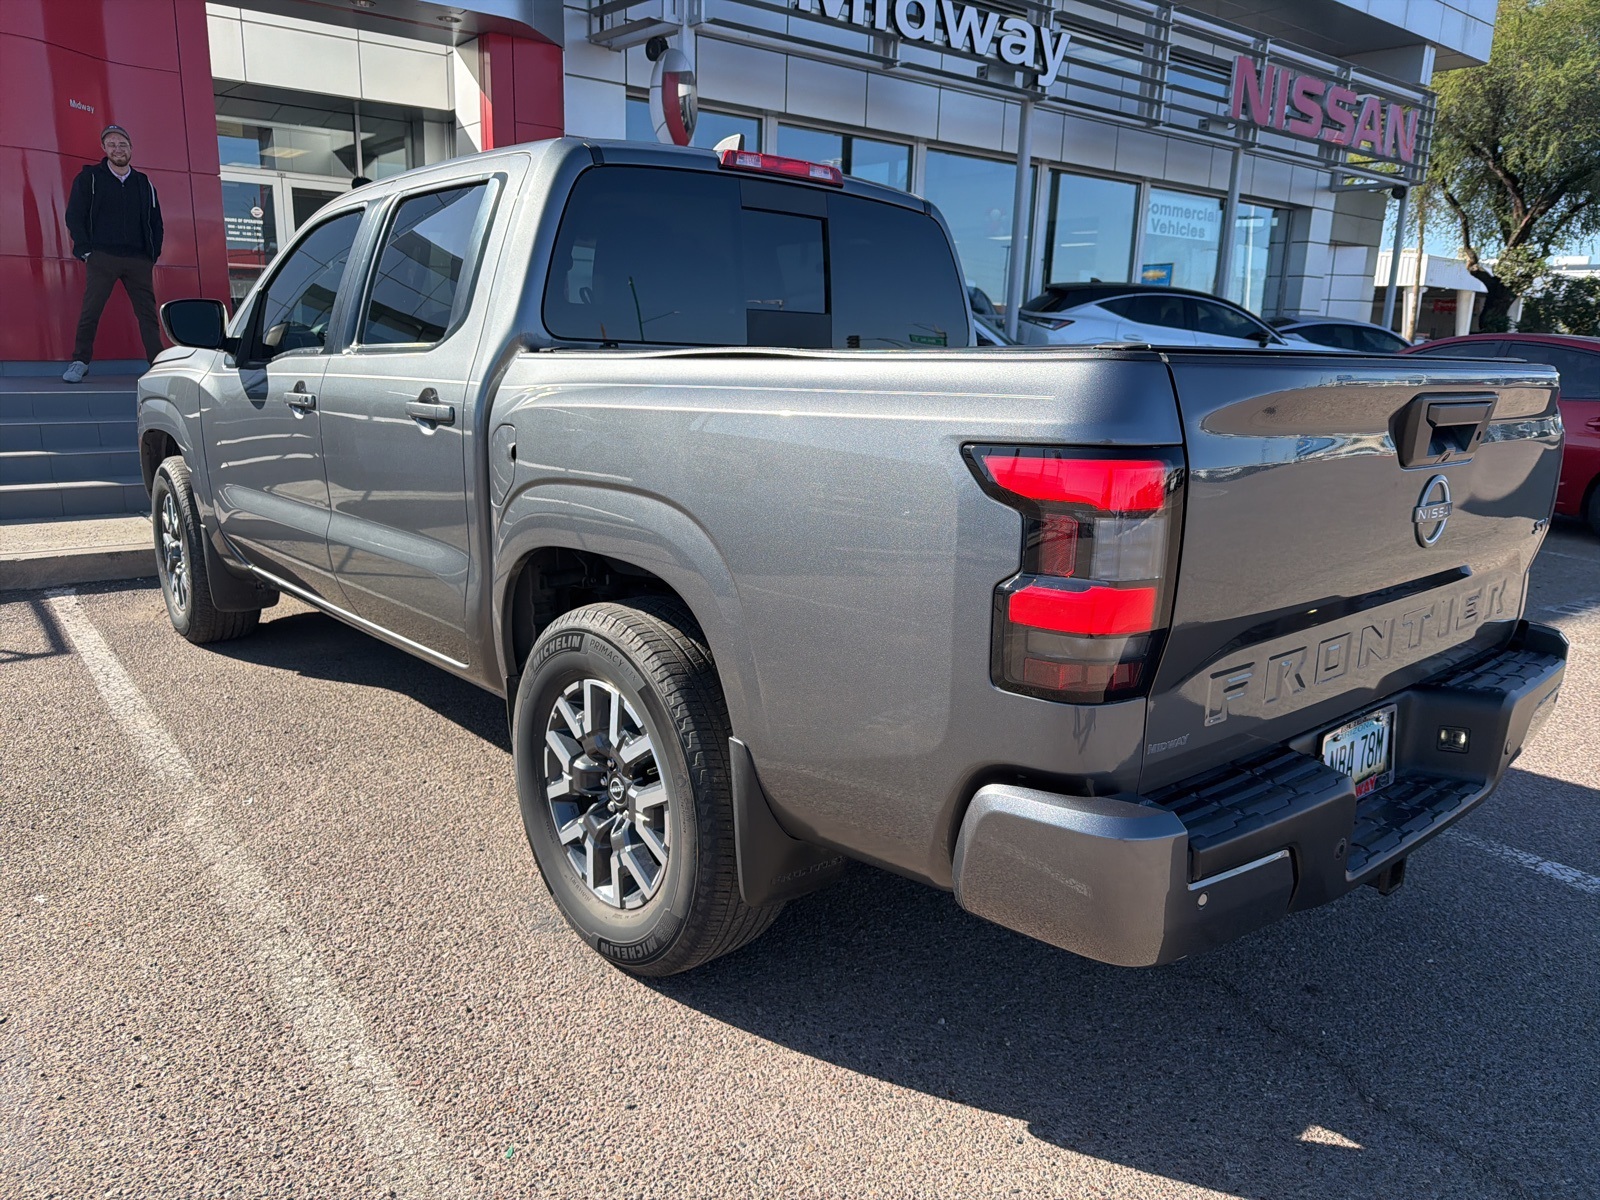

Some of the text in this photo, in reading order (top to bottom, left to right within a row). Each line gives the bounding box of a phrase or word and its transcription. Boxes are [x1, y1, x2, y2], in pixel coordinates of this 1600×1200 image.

[1229, 55, 1419, 163] NISSAN
[1148, 203, 1218, 223] ommercial
[1151, 218, 1206, 239] Vehicles
[532, 634, 582, 671] MICHELIN
[589, 638, 624, 668] PRIMACY
[1204, 578, 1508, 727] FRONTIER
[1360, 726, 1385, 773] 78M
[600, 935, 659, 960] MICHELIN
